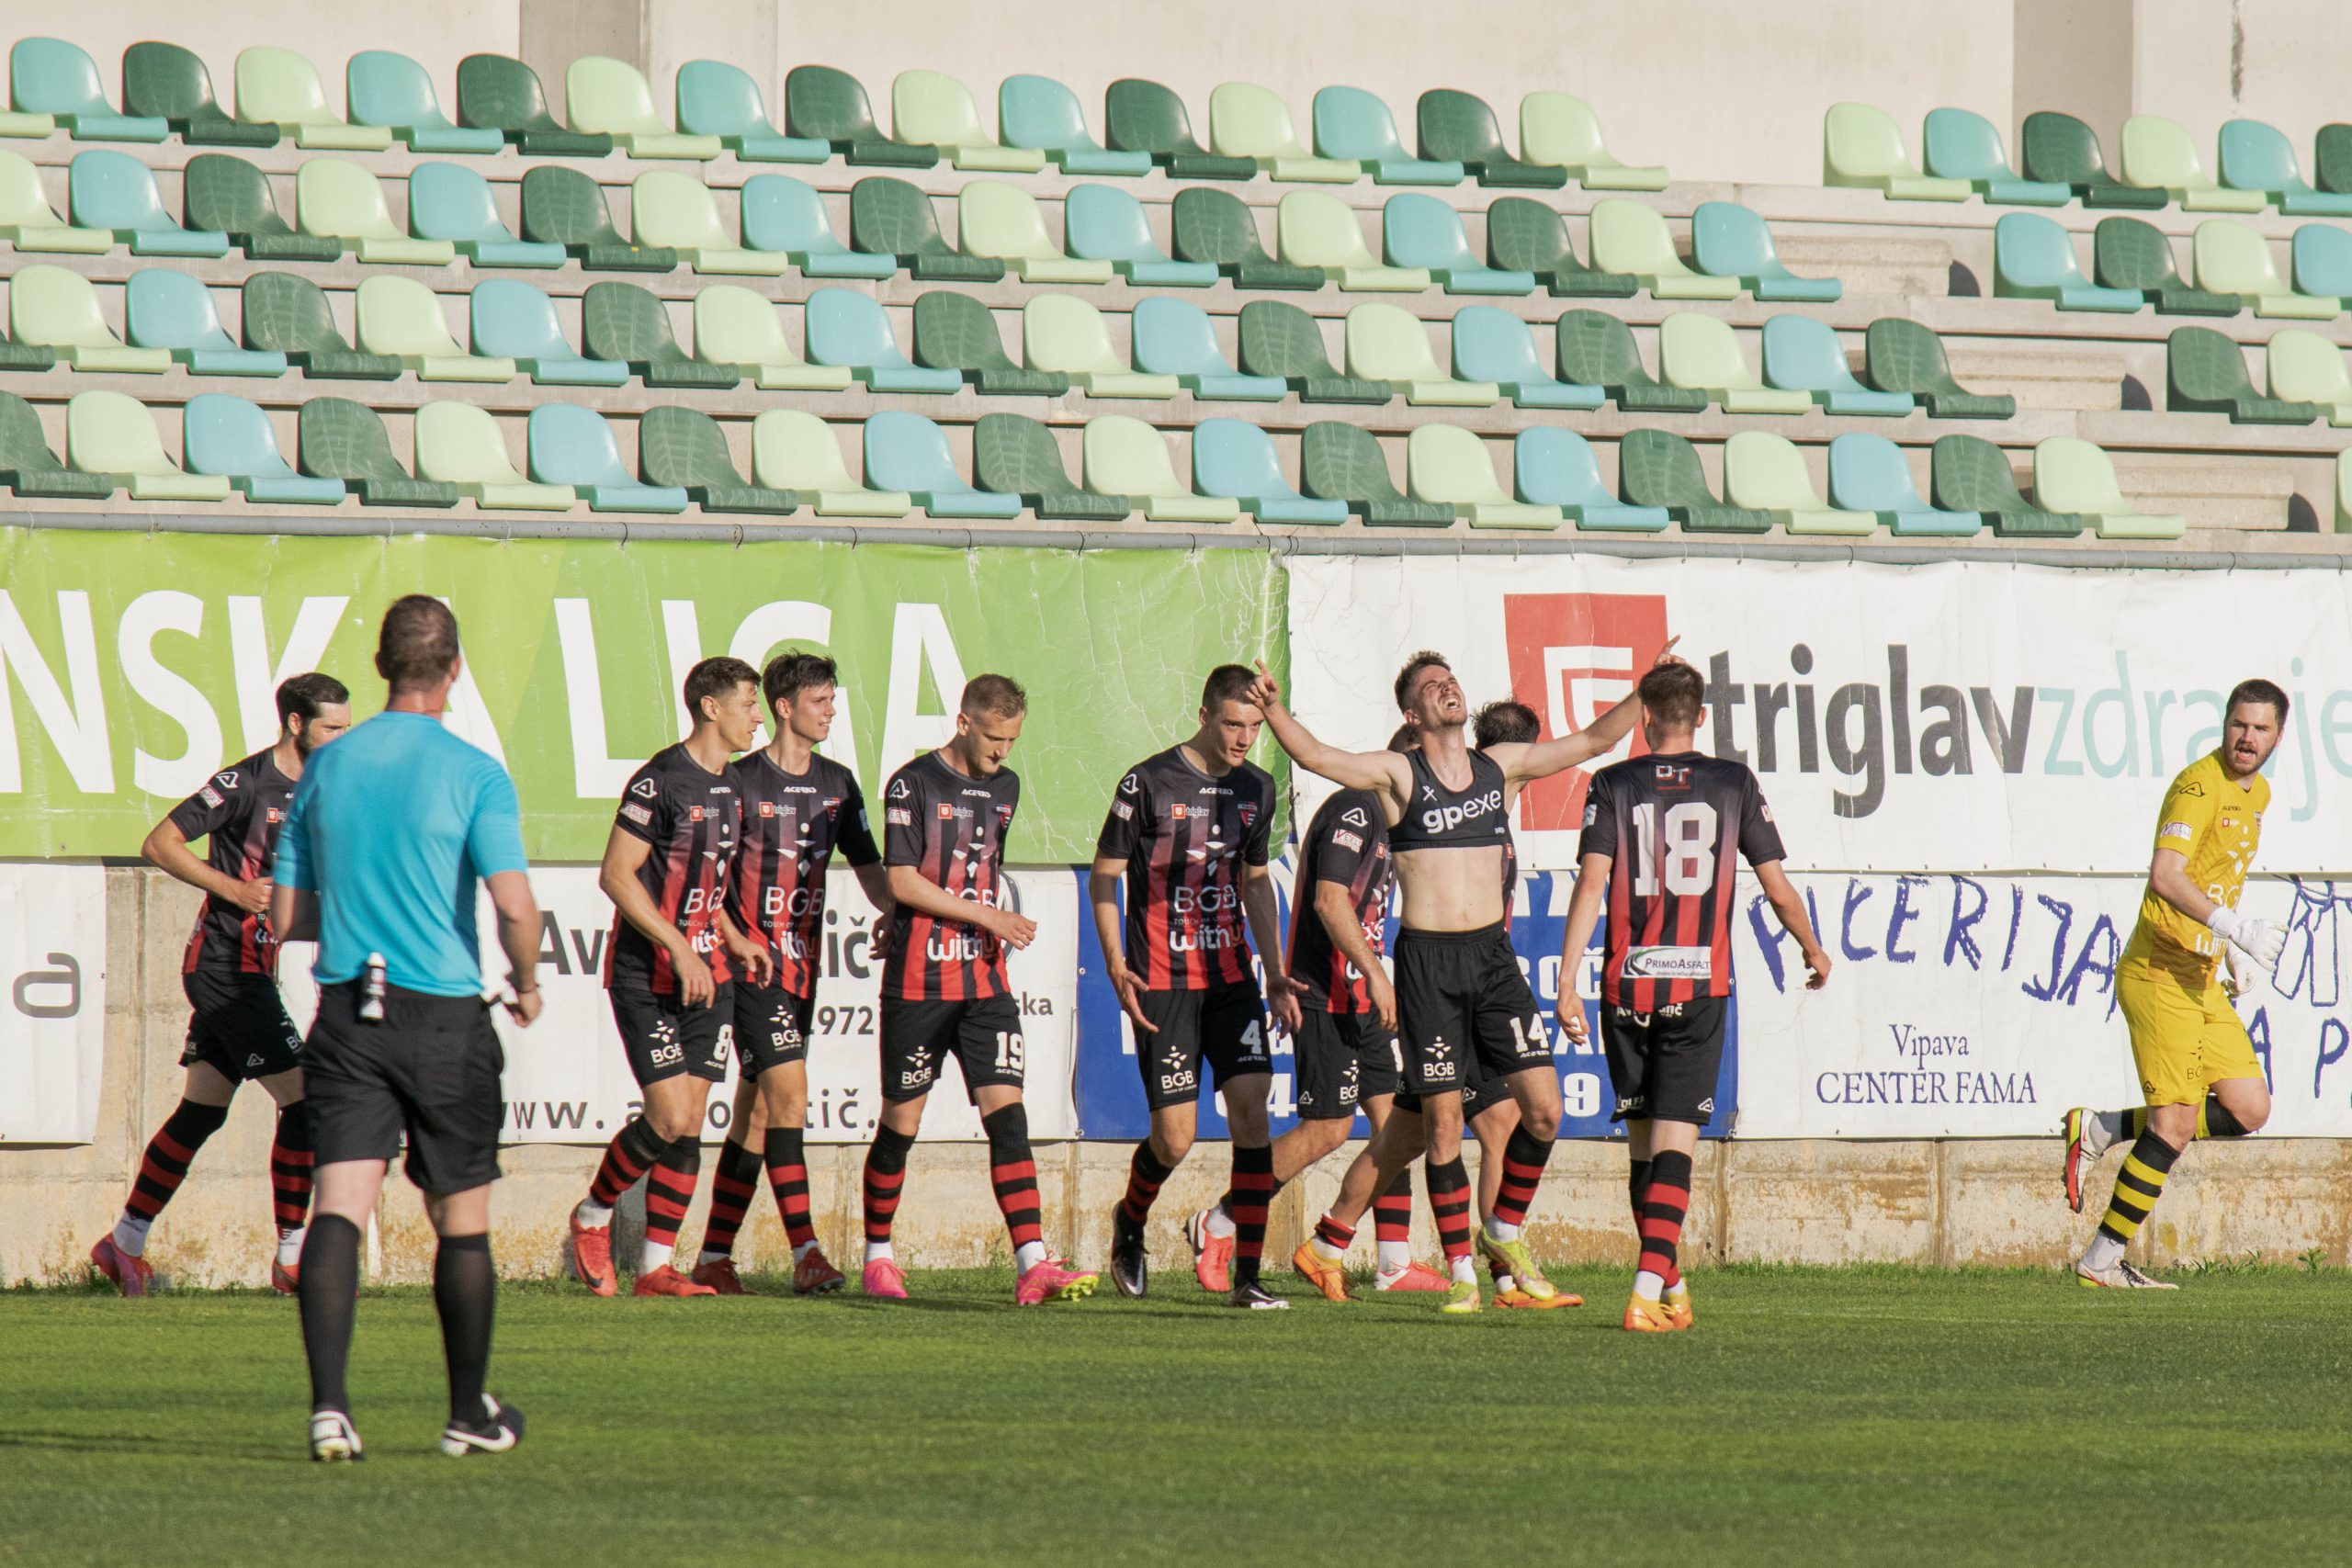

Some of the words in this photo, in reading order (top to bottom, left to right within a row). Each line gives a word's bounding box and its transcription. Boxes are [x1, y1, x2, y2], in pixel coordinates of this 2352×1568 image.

[1185, 807, 1210, 818] triglav
[1422, 789, 1501, 834] gpexe
[1633, 802, 1718, 898] 18
[765, 886, 825, 916] BGB
[809, 1005, 874, 1035] 972
[1510, 1013, 1550, 1053] 14
[713, 1023, 733, 1061] 8
[995, 1032, 1024, 1071] 19
[1240, 1020, 1262, 1055] 4
[1889, 1023, 1970, 1071] Vipava
[901, 1066, 933, 1086] BGB
[1161, 1070, 1194, 1089] BGB
[1423, 1062, 1455, 1077] BGB
[1816, 1071, 1950, 1104] CENTER
[1955, 1071, 2038, 1104] FAMA
